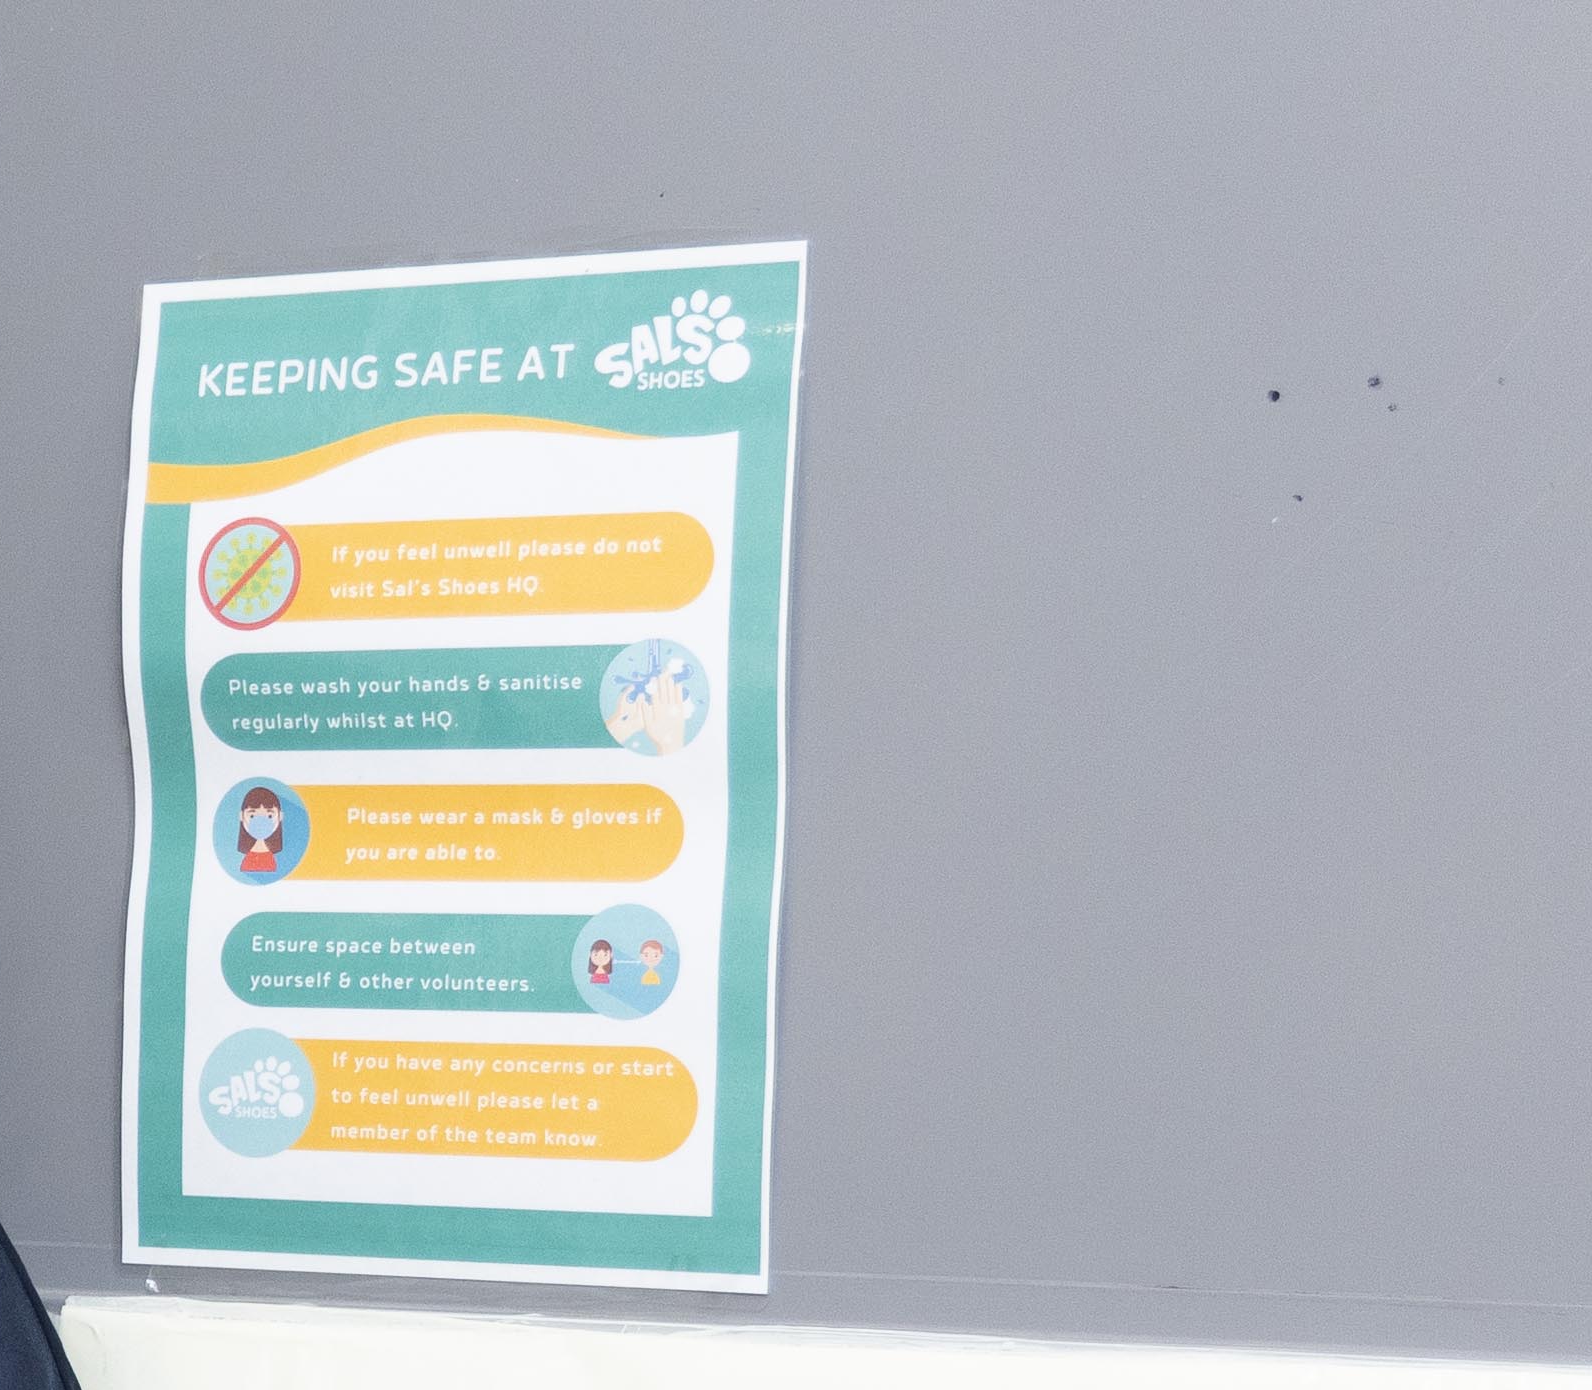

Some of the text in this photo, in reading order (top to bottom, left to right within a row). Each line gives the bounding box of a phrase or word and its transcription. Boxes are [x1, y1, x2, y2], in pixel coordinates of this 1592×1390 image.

[594, 315, 715, 389] SALS
[198, 343, 576, 398] KEEPING SAFE AT
[637, 368, 706, 391] SHOES
[332, 535, 663, 567] If you feel unwell please do not
[330, 574, 544, 599] visit Sal's Shoes HQ.
[228, 673, 586, 698] Please wash your hands & sanitise
[232, 710, 460, 735] regularly whilst at HQ.
[347, 806, 663, 830] Please wear a mask & gloves if
[345, 843, 502, 865] you are able to.
[252, 935, 476, 958] Ensure space between
[250, 971, 535, 993] yourself & other volunteers.
[332, 1051, 678, 1077] If you have any concerns or start
[208, 1071, 282, 1116] SALS
[331, 1087, 600, 1113] to feel unwell please let a
[233, 1104, 278, 1120] SHOES
[330, 1123, 604, 1147] member of the team know.
